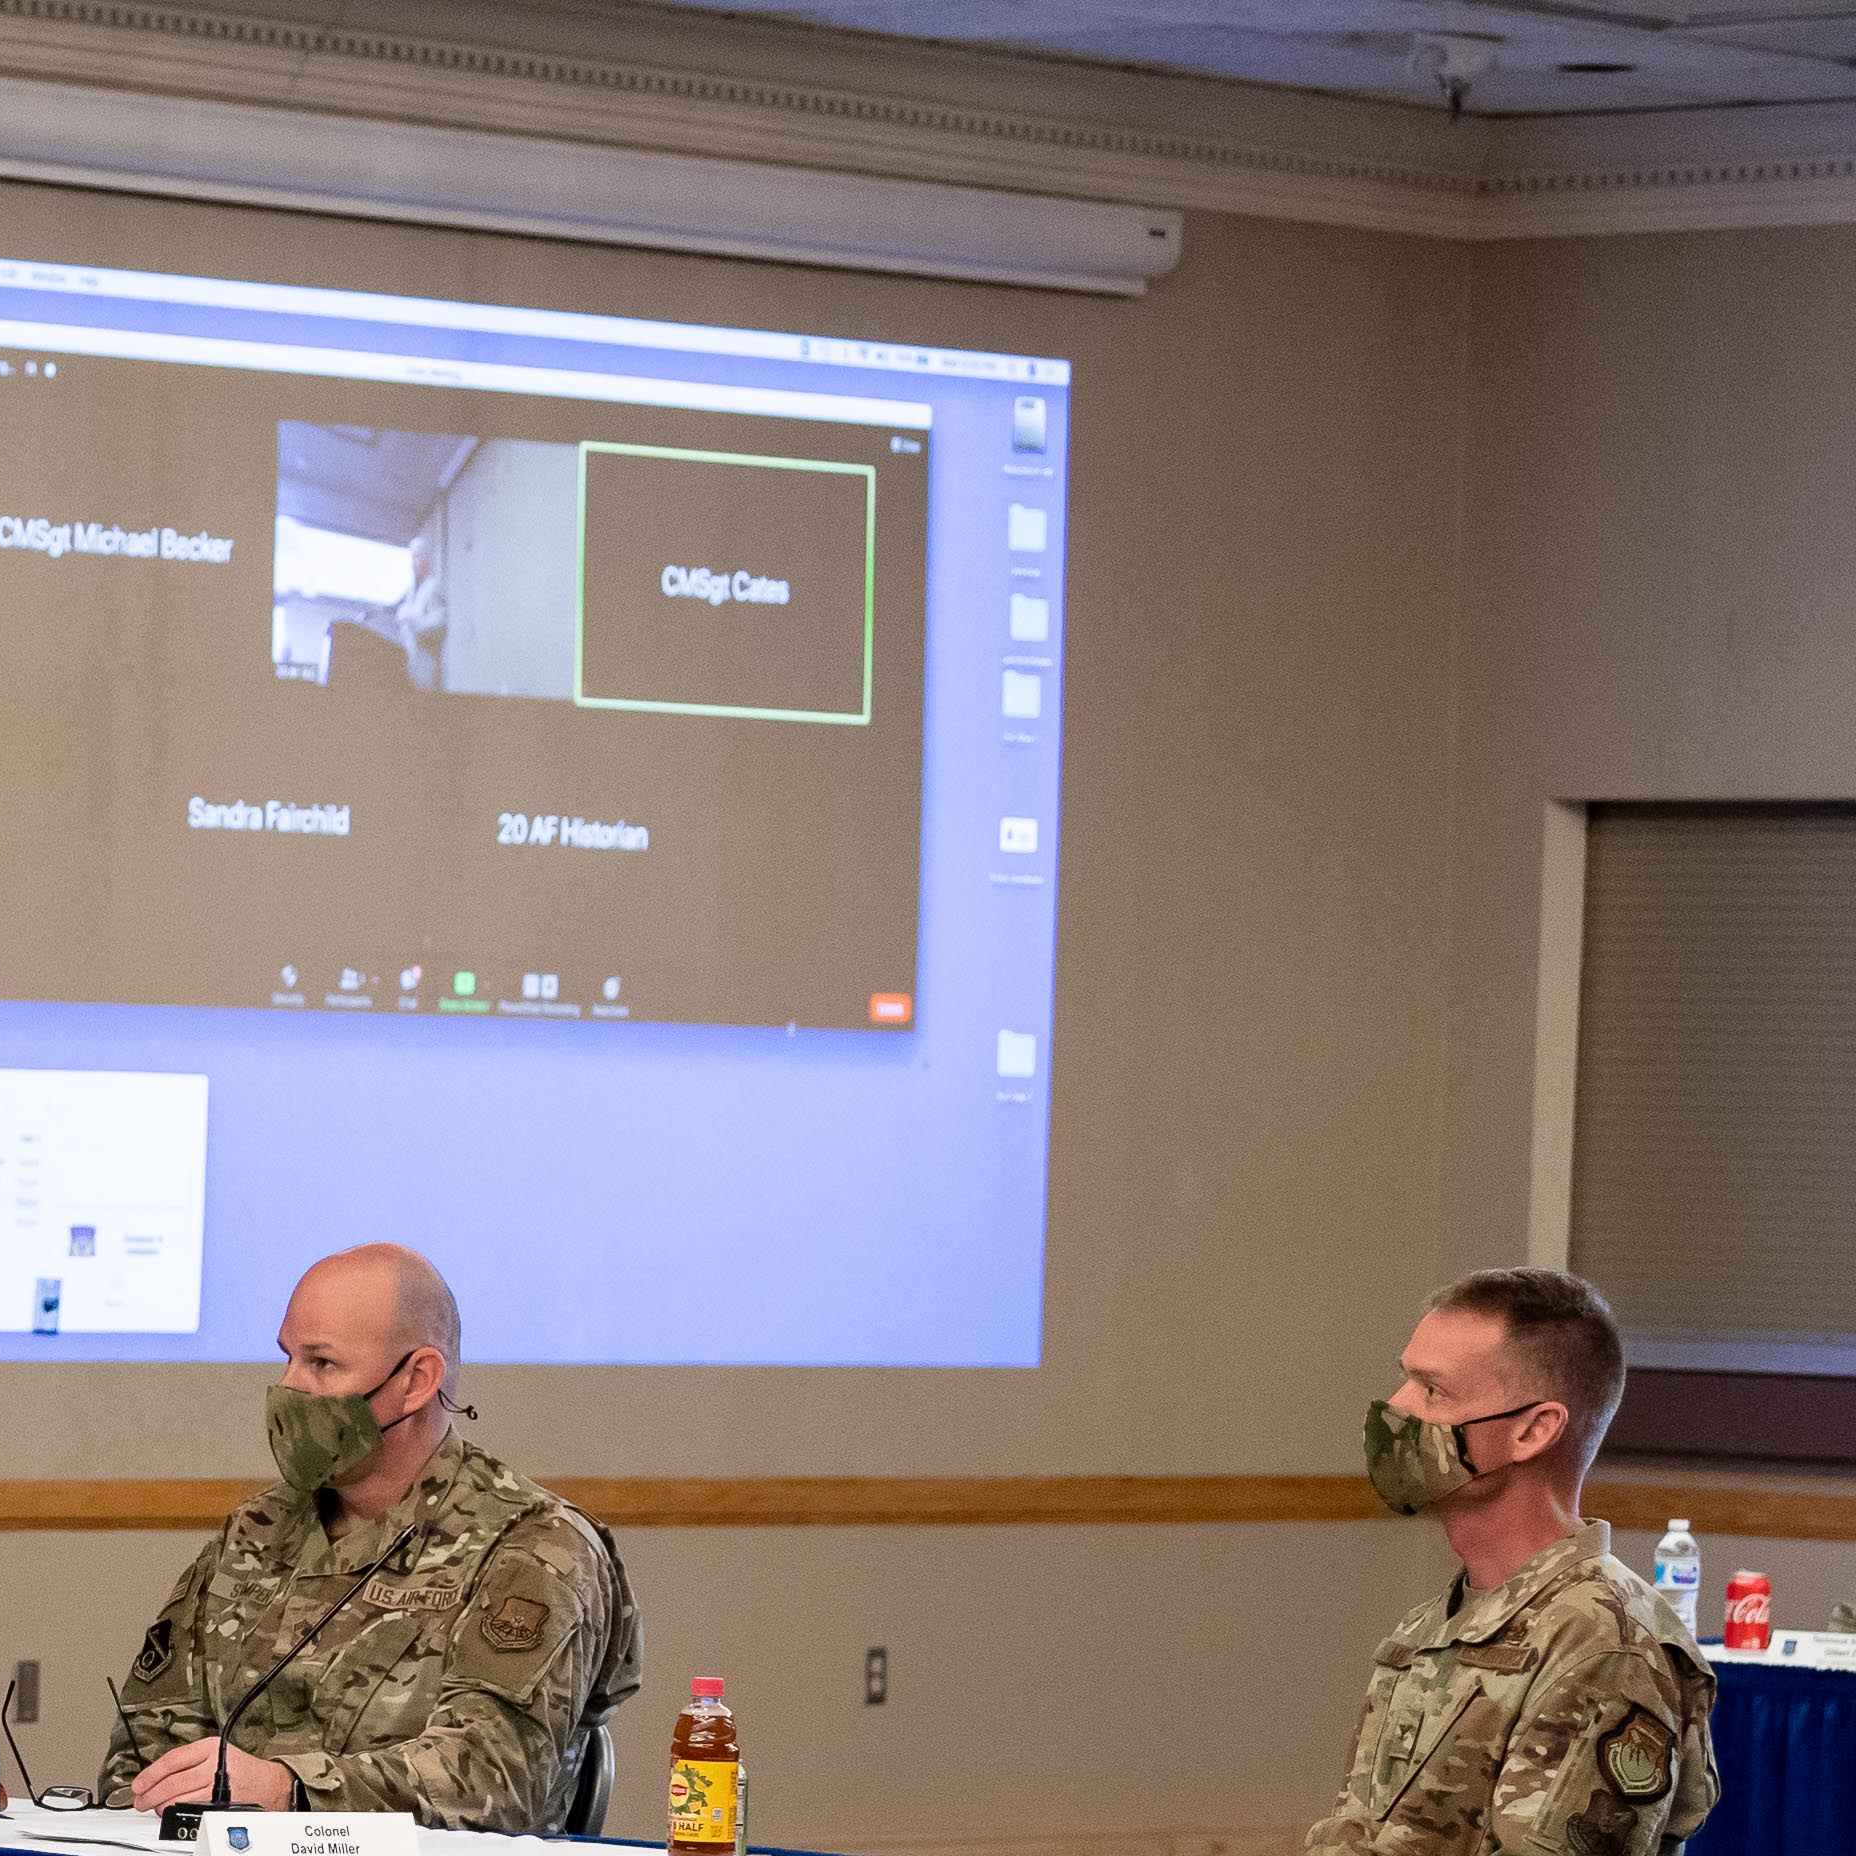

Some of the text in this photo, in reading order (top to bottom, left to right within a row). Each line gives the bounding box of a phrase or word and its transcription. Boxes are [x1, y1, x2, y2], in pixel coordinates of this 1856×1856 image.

[74, 520, 159, 558] Michael
[160, 527, 235, 564] Becker
[661, 565, 730, 606] CMSgt
[187, 796, 352, 836] Sandra Fairchild
[497, 812, 650, 851] 20 AF Historian
[304, 1825, 350, 1837] Colonel
[678, 1821, 704, 1832] HALF
[291, 1843, 361, 1855] David Miller
